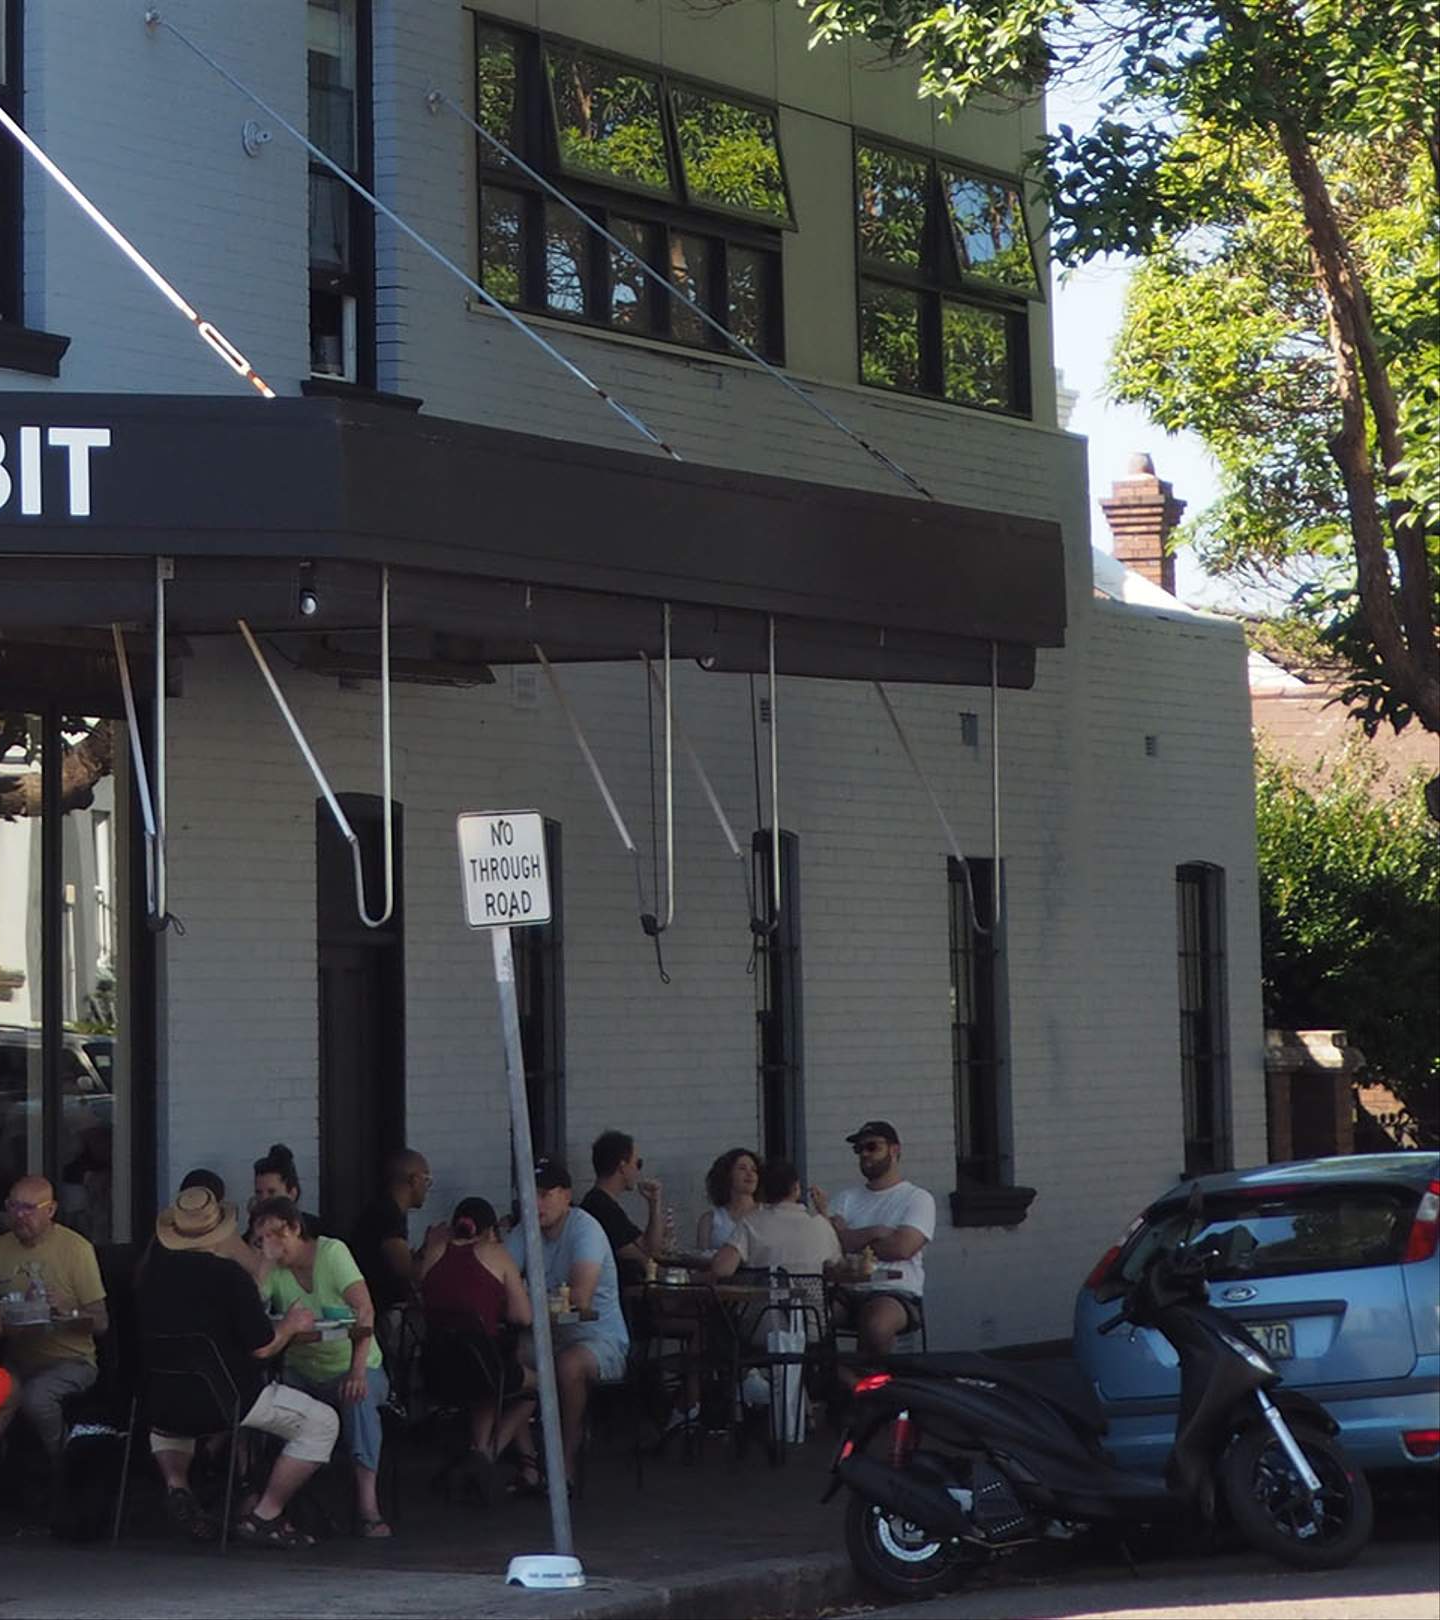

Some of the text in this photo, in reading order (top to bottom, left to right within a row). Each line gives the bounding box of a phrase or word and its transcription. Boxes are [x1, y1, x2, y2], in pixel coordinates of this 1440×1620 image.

[490, 821, 514, 846] NO
[470, 855, 541, 882] THROUGH
[485, 890, 532, 917] ROAD
